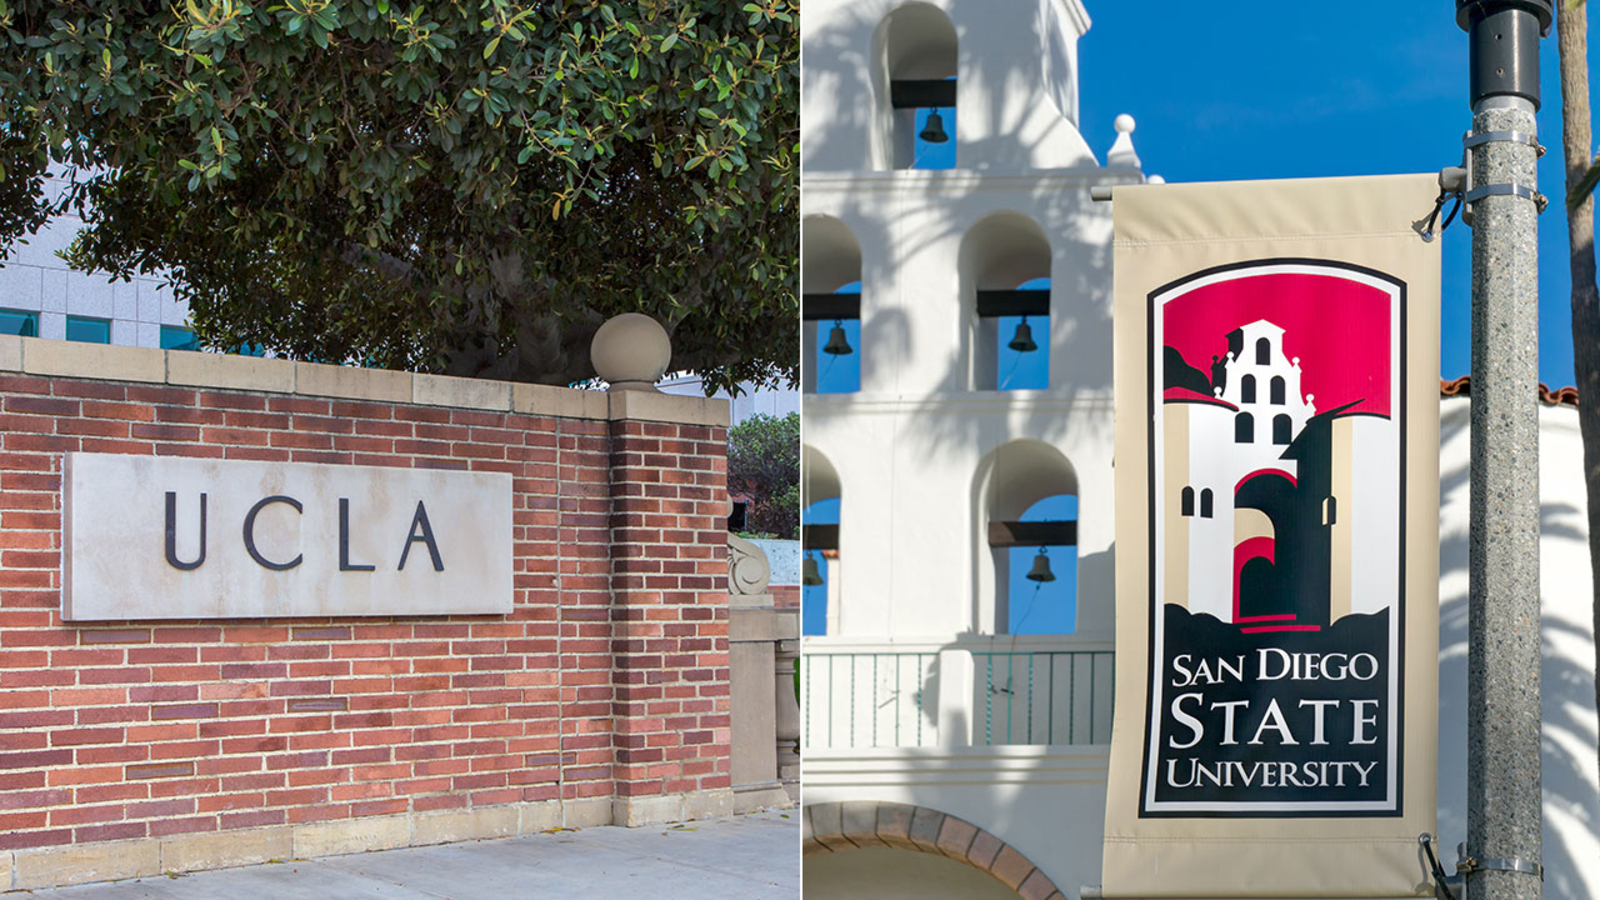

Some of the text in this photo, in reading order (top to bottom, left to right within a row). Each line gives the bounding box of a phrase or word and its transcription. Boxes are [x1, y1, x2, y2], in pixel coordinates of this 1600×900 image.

[164, 491, 445, 572] UCLA
[1171, 647, 1379, 687] SAN DIEGO
[1169, 692, 1379, 749] STATE
[1166, 757, 1378, 788] UNIVERSITY
